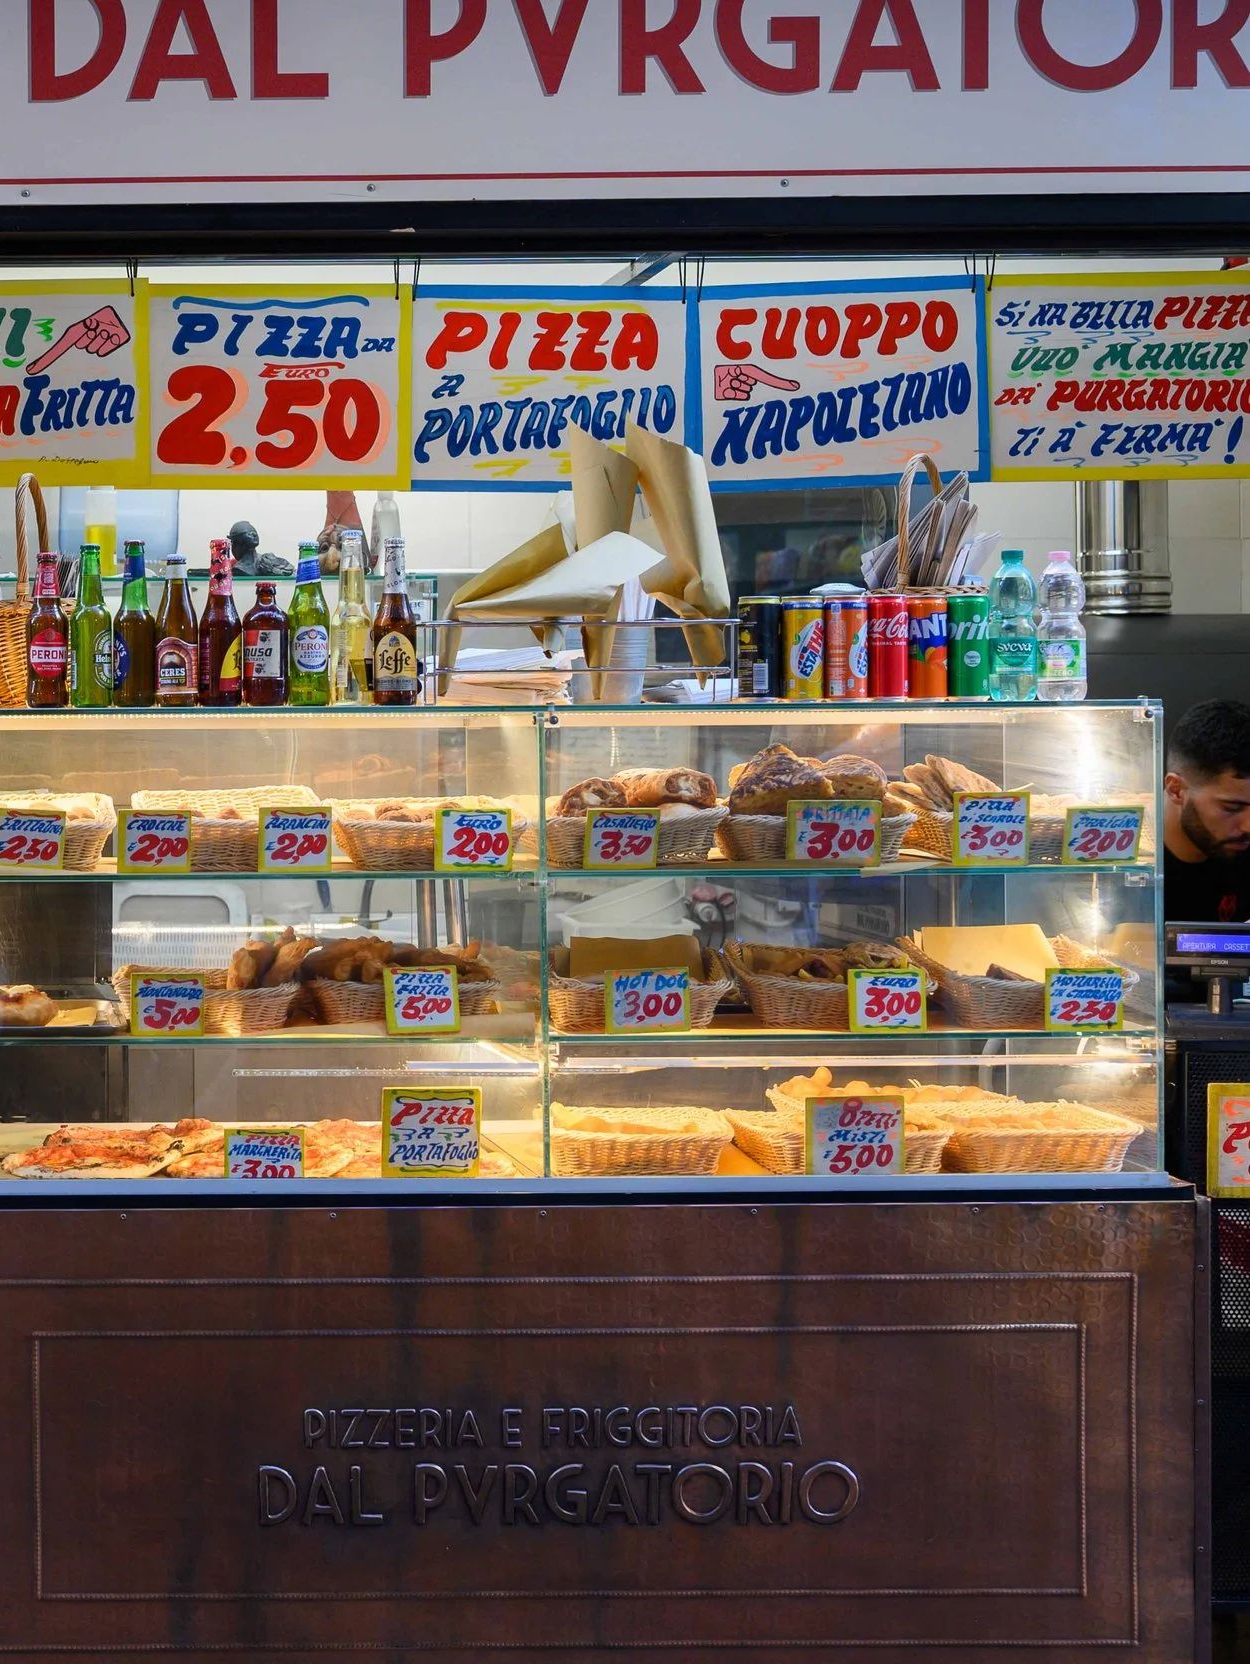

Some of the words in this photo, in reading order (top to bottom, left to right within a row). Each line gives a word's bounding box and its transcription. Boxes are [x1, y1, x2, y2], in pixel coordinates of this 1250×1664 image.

[28, 0, 329, 102] DAL
[717, 300, 958, 360] CUOPPO
[1154, 295, 1250, 330] PIZZ
[172, 312, 360, 358] PIZZA
[361, 336, 395, 353] DA
[426, 310, 658, 371] PIZZA
[20, 374, 136, 437] FRITTA
[156, 364, 381, 470] 2,50
[711, 362, 972, 466] NAPOLETANO
[161, 668, 185, 677] CERES
[379, 648, 411, 674] Leffe
[265, 817, 330, 830] ARANCINI
[446, 827, 510, 863] 2,00
[395, 973, 444, 984] PIZZA
[615, 970, 654, 992] HOT
[655, 971, 688, 991] DOG
[391, 1102, 475, 1128] PIZZA
[245, 1134, 300, 1145] PIZZA
[304, 1407, 484, 1448] PIZZERIA
[503, 1408, 523, 1447] E
[543, 1405, 803, 1447] FRIGGITORIA
[258, 1464, 385, 1526] DAL
[414, 1459, 860, 1526] PVRGATORIO
